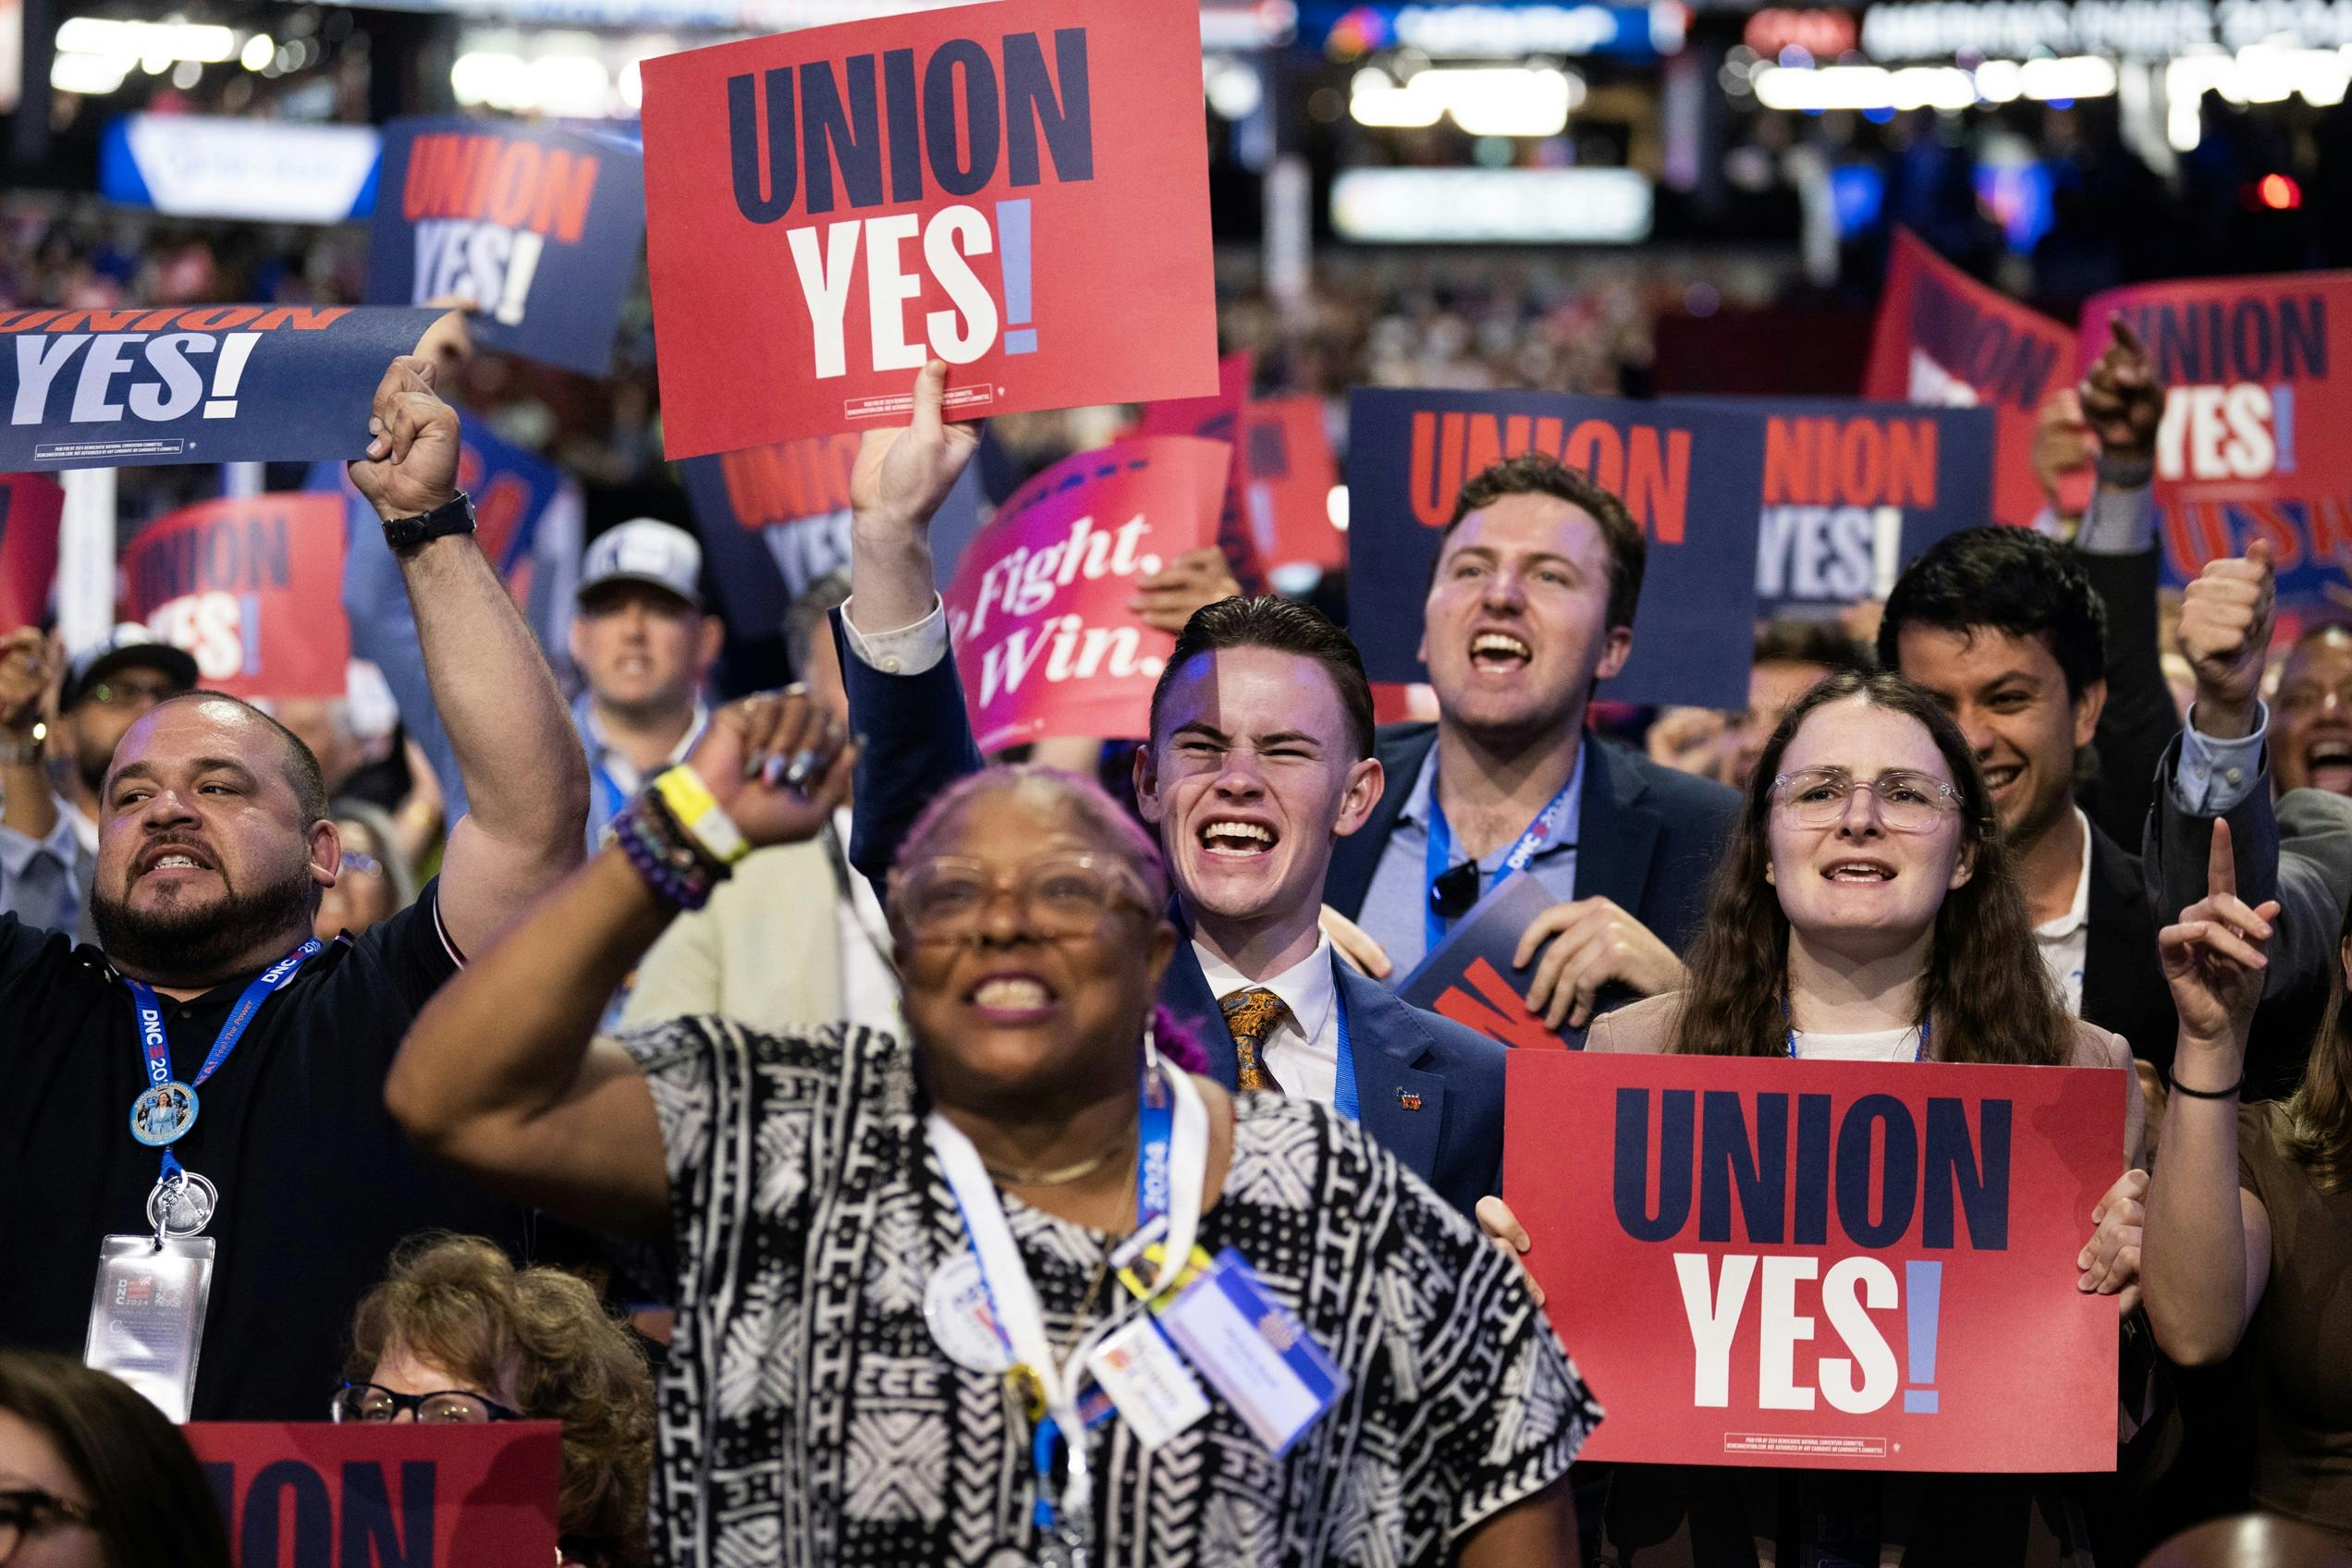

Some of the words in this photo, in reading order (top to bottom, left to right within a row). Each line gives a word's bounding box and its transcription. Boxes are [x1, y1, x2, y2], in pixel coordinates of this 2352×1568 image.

[728, 27, 1095, 224] UNION
[402, 132, 600, 244] UNION
[411, 219, 545, 326] YES!
[786, 198, 1038, 379] YES!
[11, 331, 263, 425] YES!
[2122, 293, 2328, 385] NION
[1764, 415, 1939, 510] NION
[967, 513, 1163, 640] Fight.
[978, 614, 1166, 711] Win.
[1506, 833, 1541, 869] DNC
[261, 958, 299, 985] DNC
[142, 1009, 164, 1046] DNC
[151, 1057, 169, 1084] 20
[215, 1041, 228, 1059] Feel
[225, 1023, 239, 1042] The
[232, 999, 253, 1026] Power
[1613, 1087, 2013, 1251] UNION
[1673, 1253, 1942, 1415] YES!
